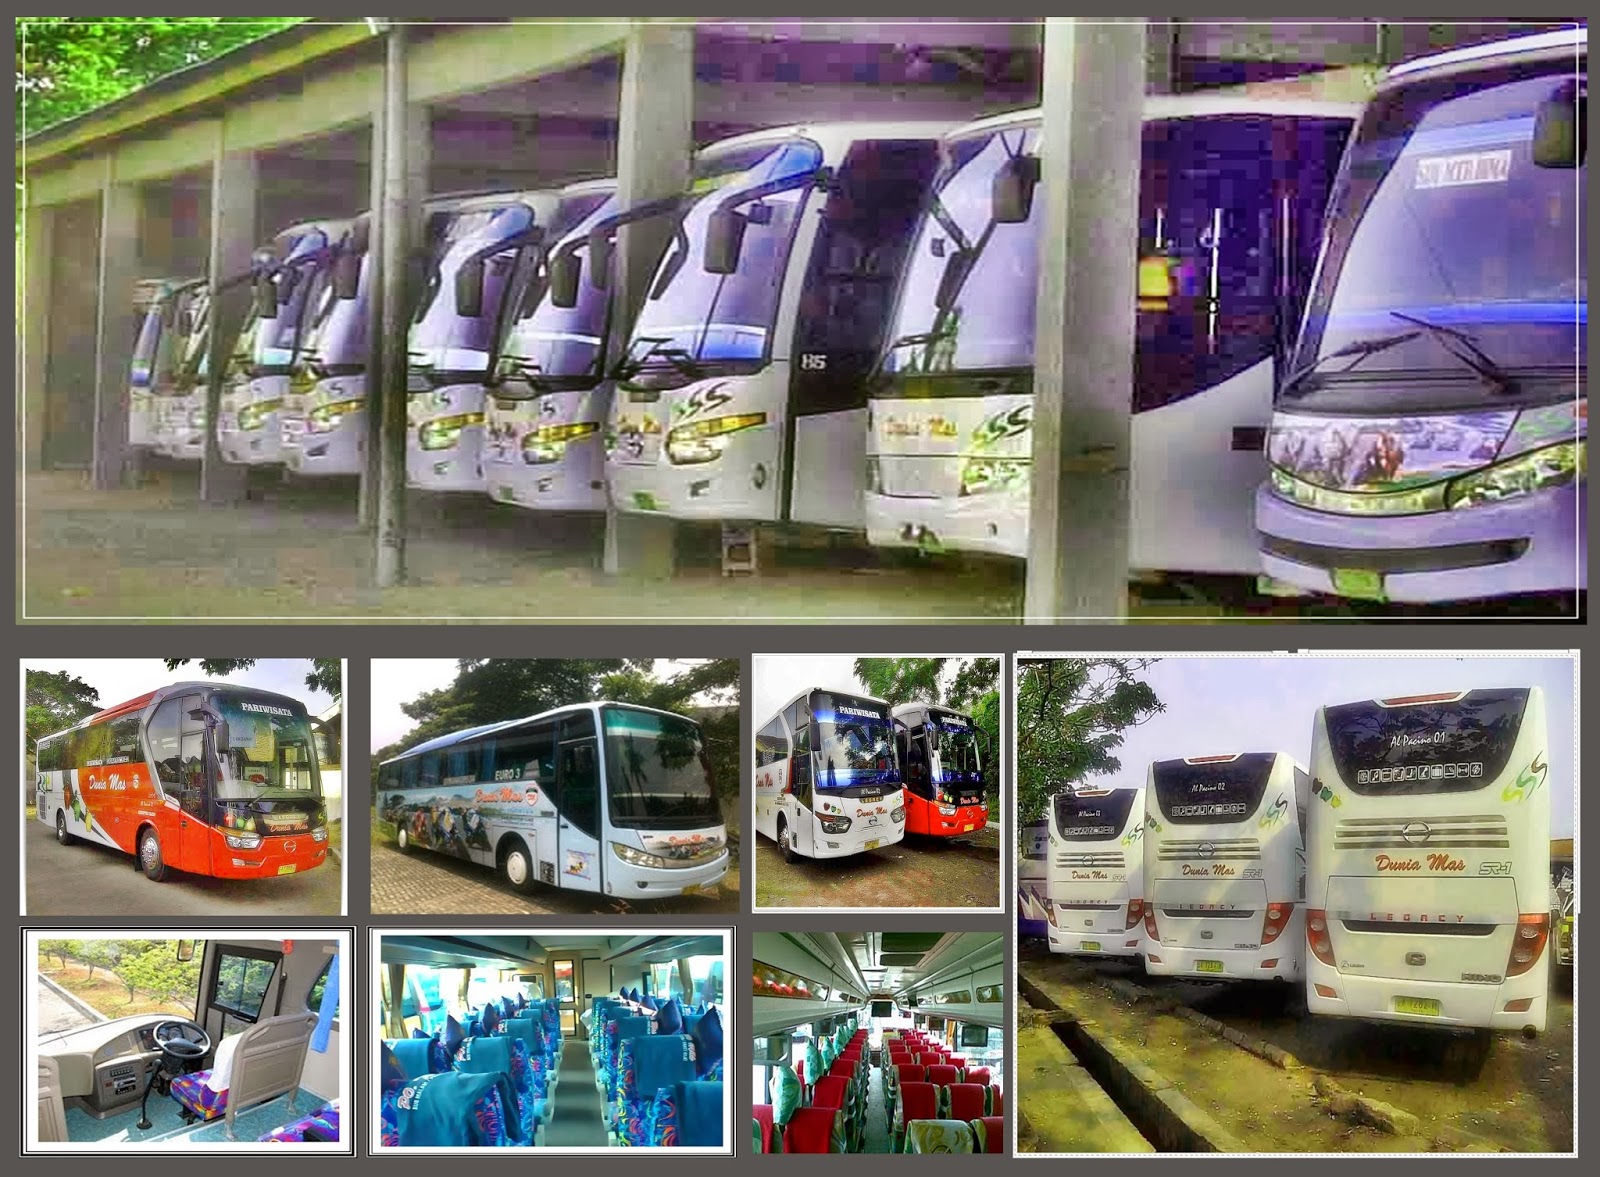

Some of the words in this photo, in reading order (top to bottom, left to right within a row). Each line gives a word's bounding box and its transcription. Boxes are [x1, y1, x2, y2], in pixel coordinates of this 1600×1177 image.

[241, 703, 293, 717] PARIWISATA
[839, 706, 880, 719] PARIWISATA
[1391, 737, 1401, 747] Al
[1403, 734, 1431, 747] Pacino
[1434, 731, 1445, 743] 01
[495, 769, 514, 780] EURO
[515, 768, 521, 779] 3
[109, 773, 127, 790] Mas
[856, 808, 873, 818] Dunia
[876, 806, 887, 815] Mas
[1182, 864, 1209, 876] Dunia
[1212, 864, 1235, 876] Mas
[1375, 855, 1421, 871] Dunia
[1427, 854, 1466, 871] Mas
[1479, 861, 1513, 875] SR-1
[1072, 870, 1090, 880] Dunia
[1092, 870, 1108, 880] Mas
[1370, 912, 1464, 923] LEGACY
